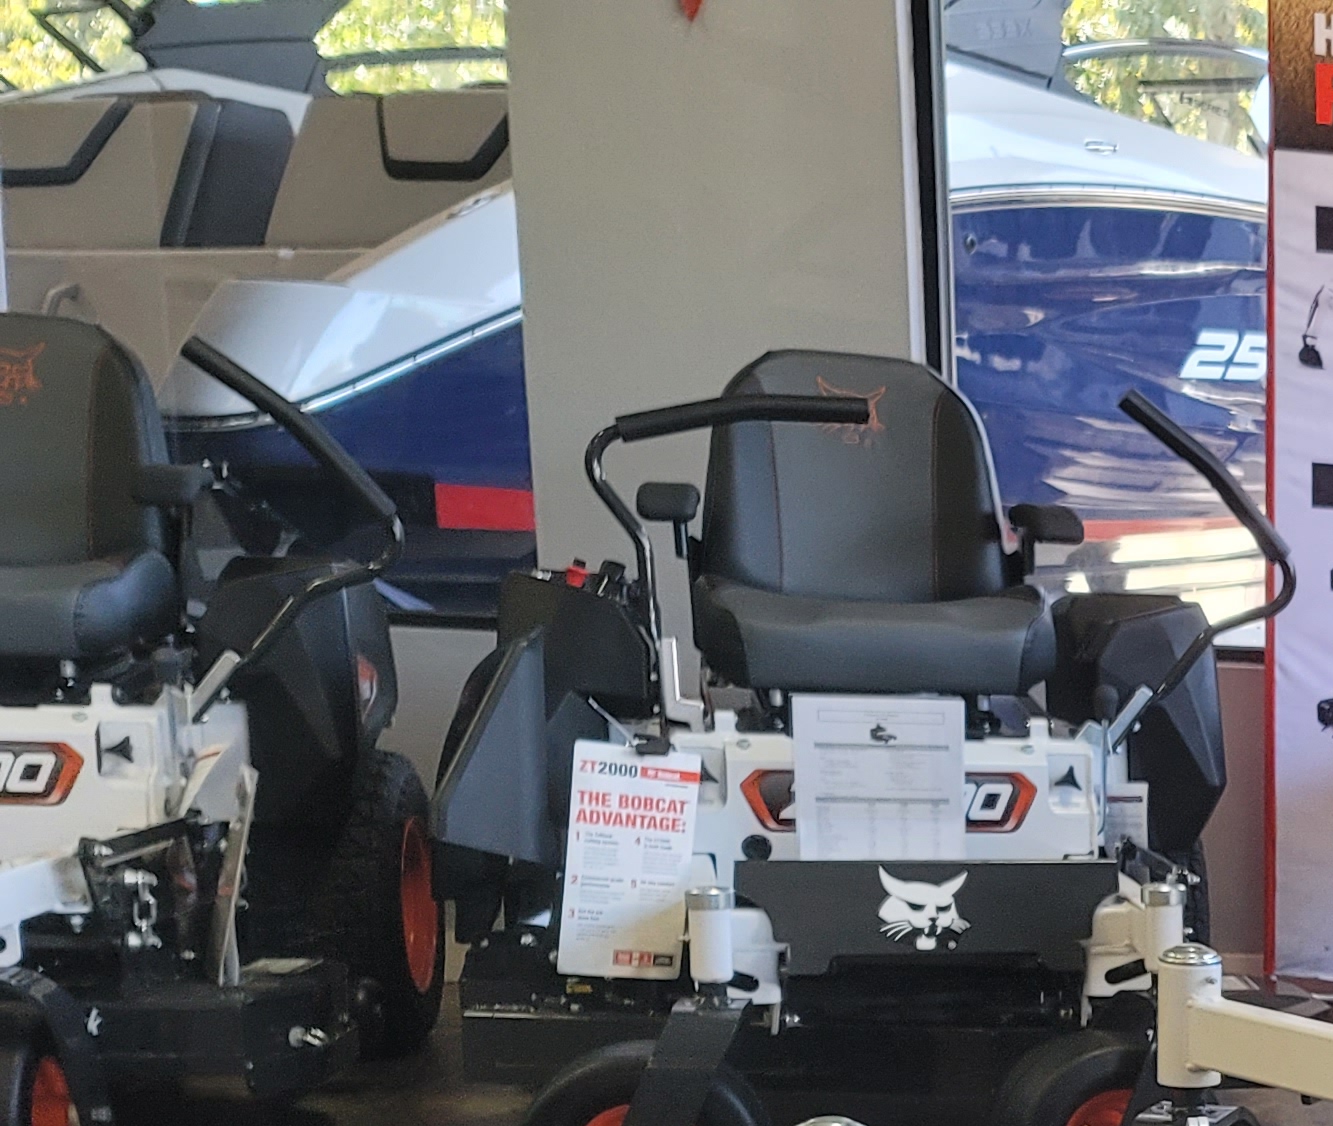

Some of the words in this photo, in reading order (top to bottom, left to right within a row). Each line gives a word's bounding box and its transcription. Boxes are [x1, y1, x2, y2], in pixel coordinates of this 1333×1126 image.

[580, 760, 638, 779] ZT2000
[577, 790, 612, 808] THE
[618, 794, 688, 816] BOBCAT
[575, 808, 687, 834] ADVANTAGE:
